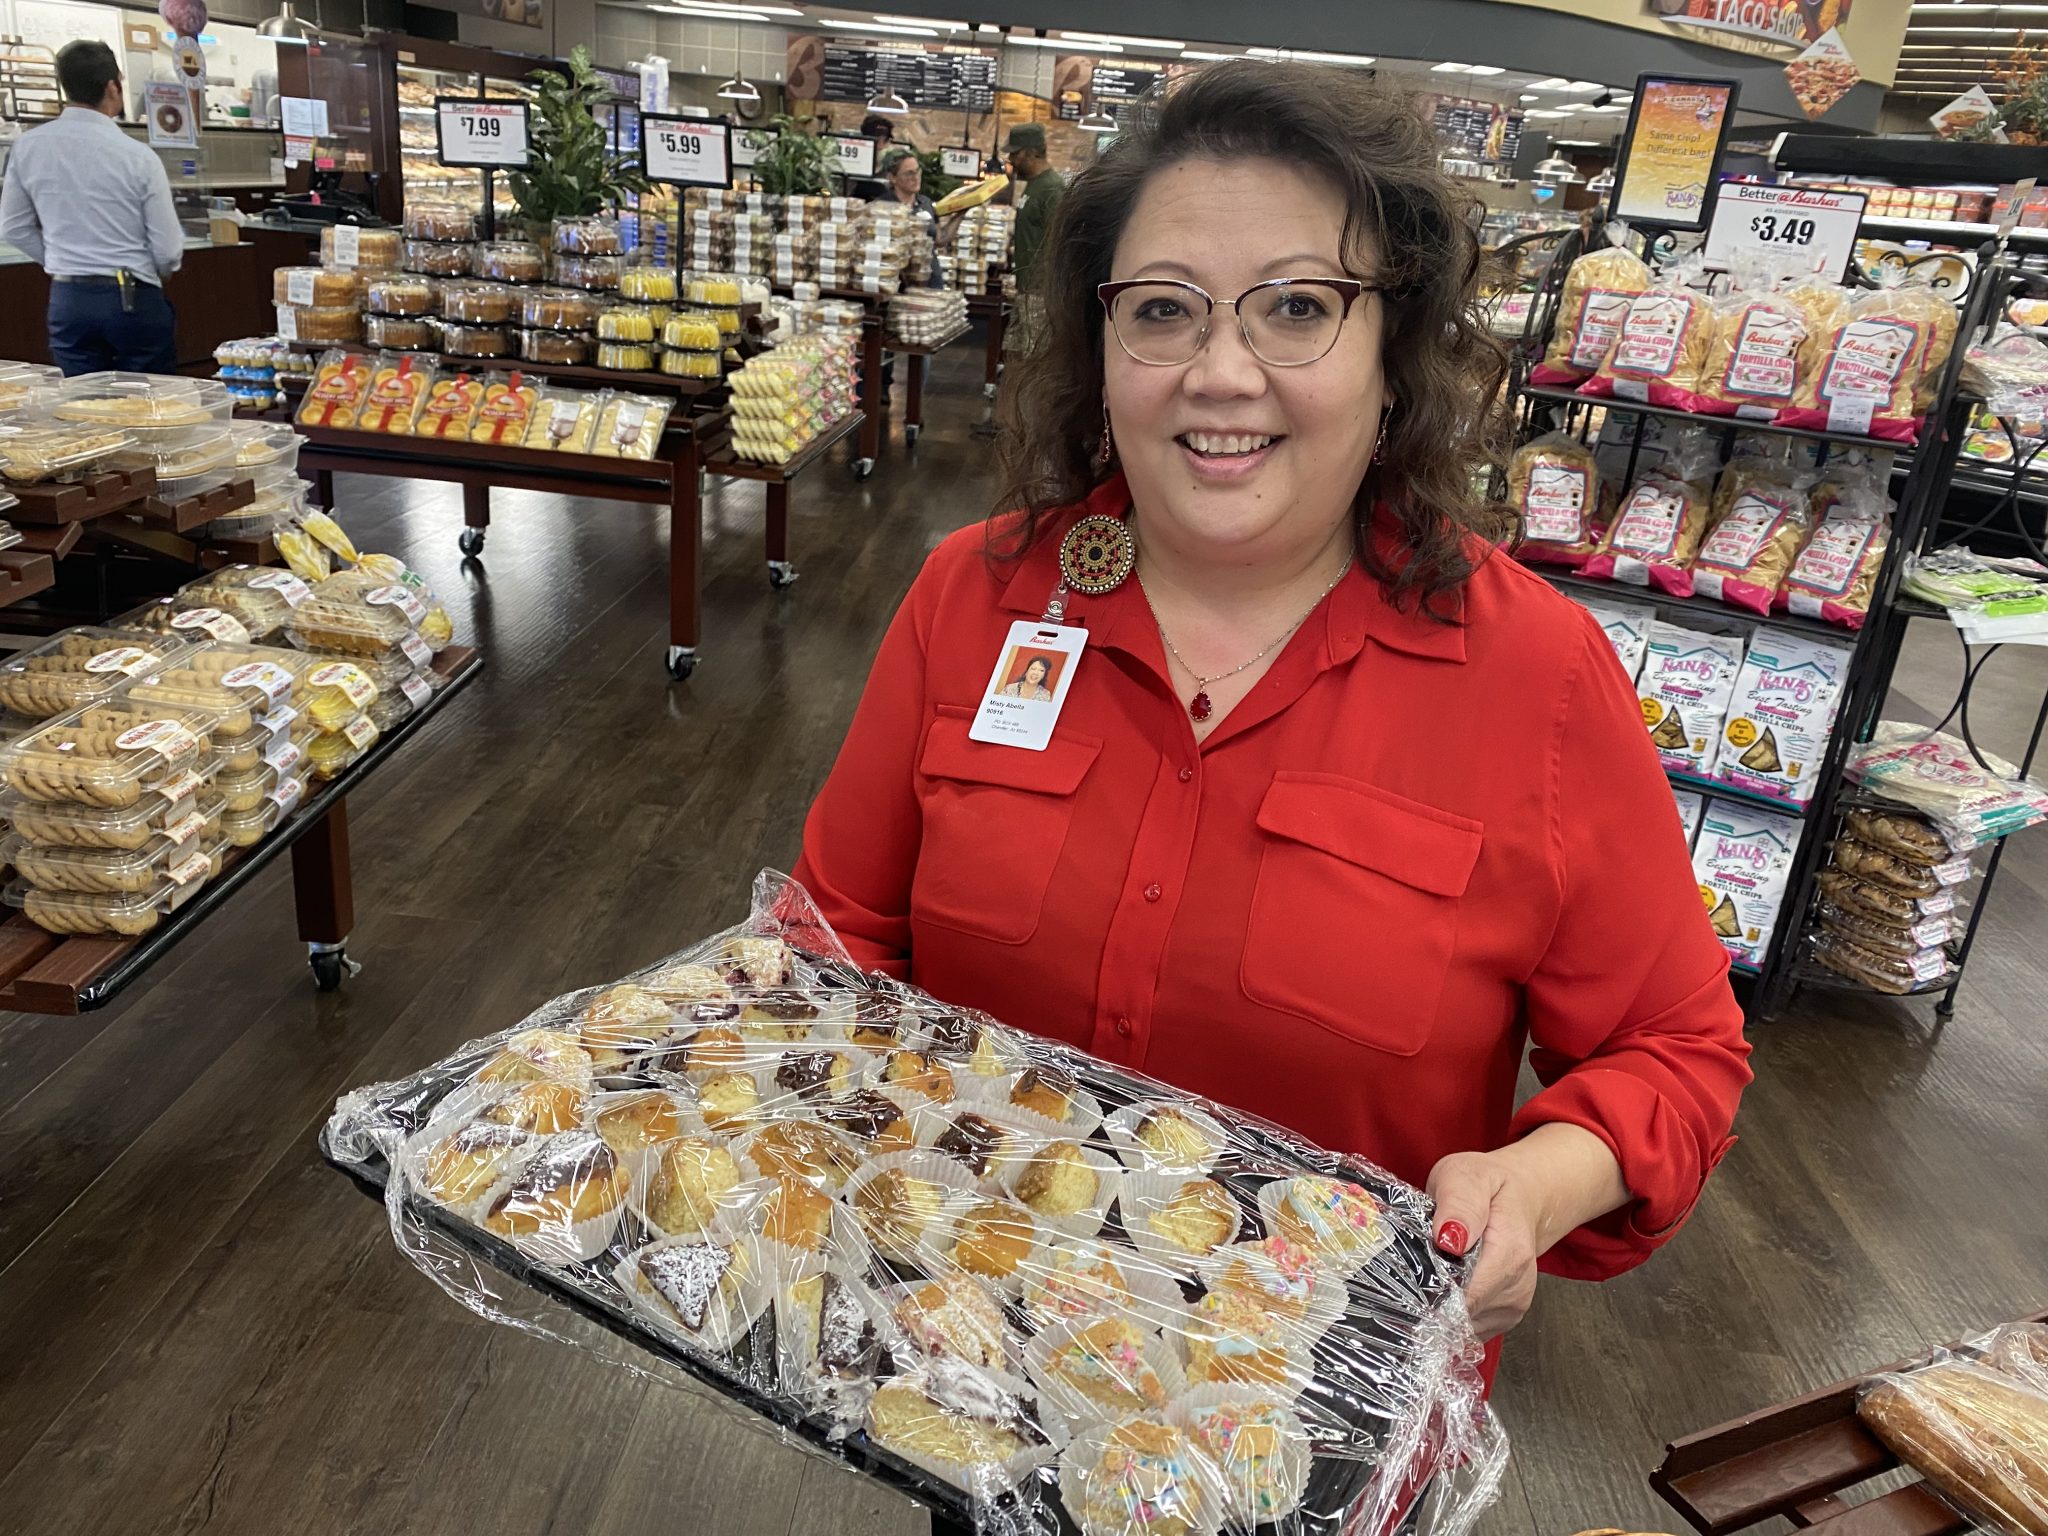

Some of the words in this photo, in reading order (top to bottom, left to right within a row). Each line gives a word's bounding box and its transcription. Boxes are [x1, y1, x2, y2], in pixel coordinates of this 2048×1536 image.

[1715, 0, 1766, 29] TACO
[1767, 6, 1804, 39] SHOP
[460, 116, 501, 137] $7.99
[1649, 130, 1675, 141] Same
[660, 132, 701, 155] $5.99
[1646, 143, 1688, 156] Different
[1689, 147, 1711, 159] bag!
[1751, 215, 1815, 246] $3.49
[1834, 360, 1871, 376] TORTILLA
[1652, 671, 1675, 683] Best
[1679, 677, 1717, 696] Tasting
[989, 700, 1005, 708] Misty
[1650, 691, 1686, 706] TORTILLA
[1686, 698, 1709, 710] CHIPS
[1747, 690, 1770, 704] Best
[1775, 697, 1813, 717] Tasting
[1743, 711, 1780, 727] TORTILLA
[1781, 722, 1805, 733] CHIPS
[1706, 858, 1729, 872] Best
[1733, 865, 1770, 884] Tasting
[1703, 879, 1739, 894] TORTILLA
[1740, 889, 1763, 900] CHIPS
